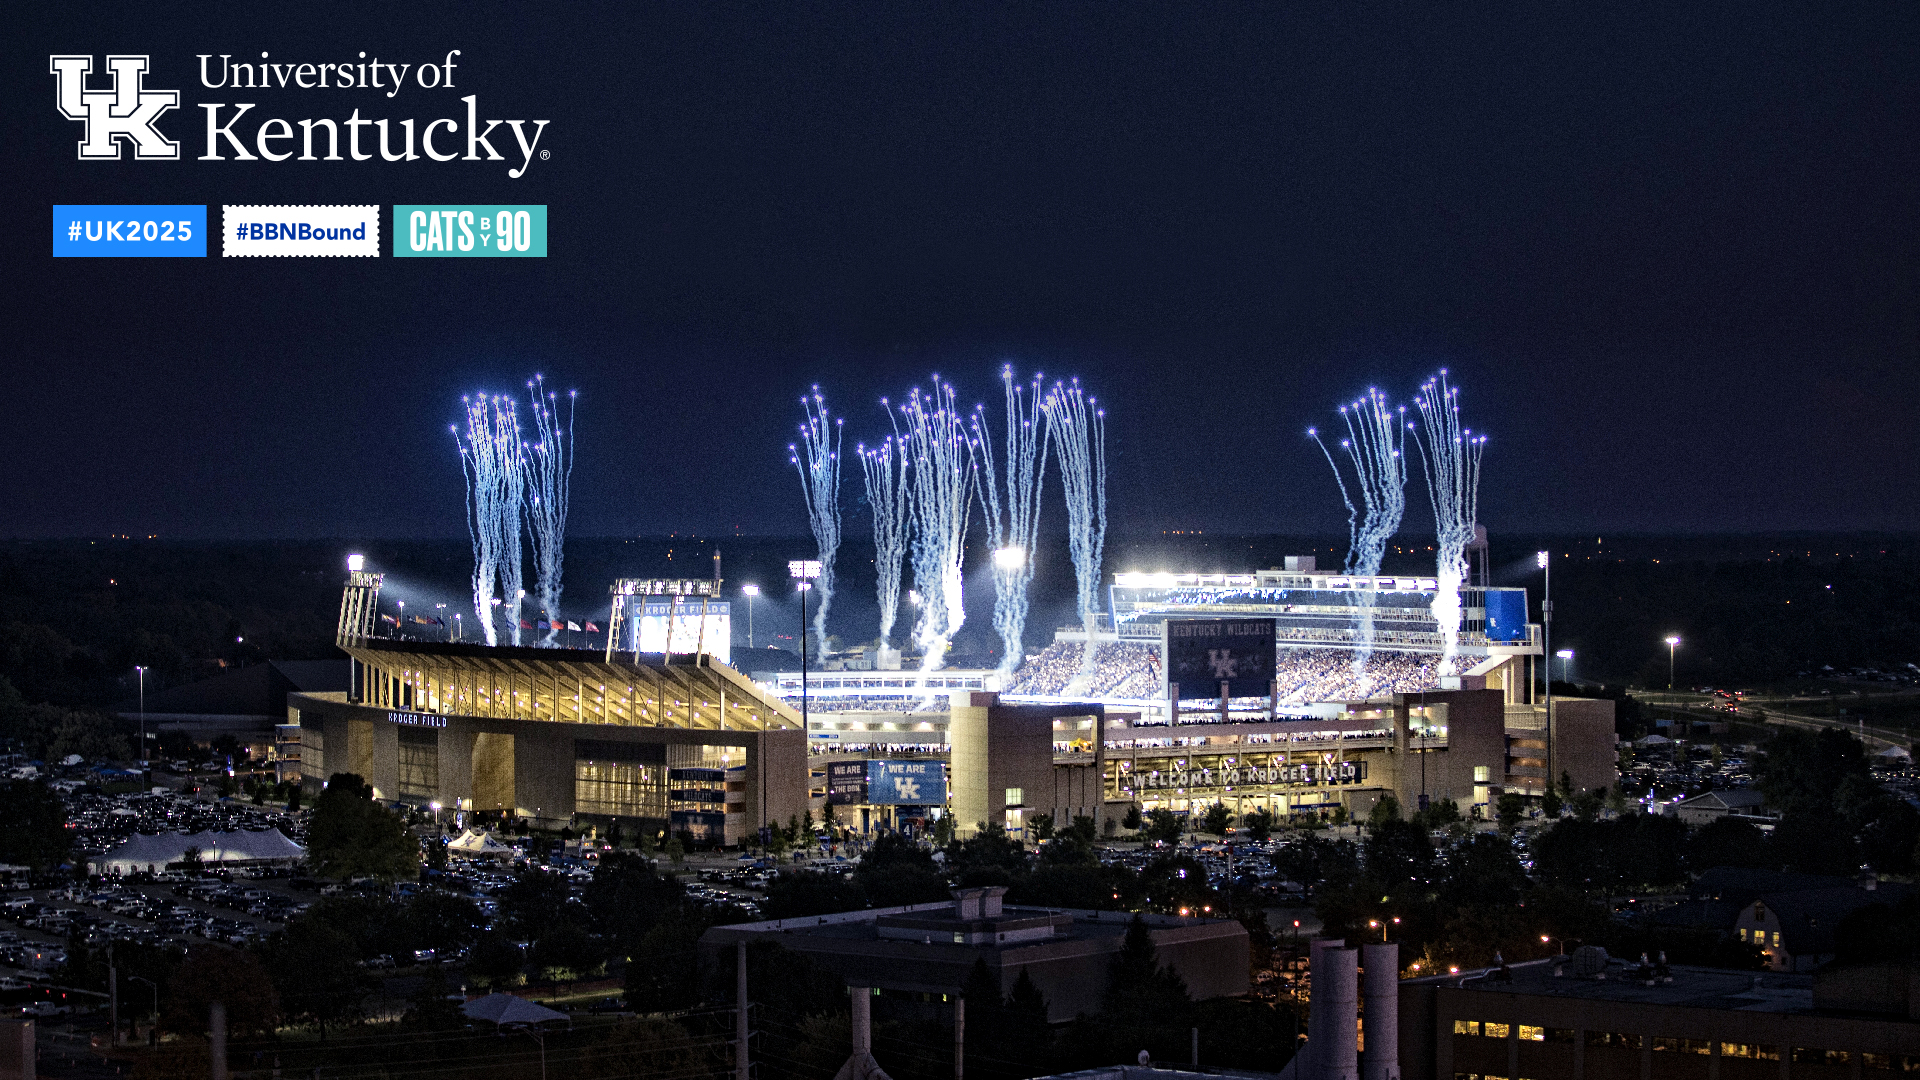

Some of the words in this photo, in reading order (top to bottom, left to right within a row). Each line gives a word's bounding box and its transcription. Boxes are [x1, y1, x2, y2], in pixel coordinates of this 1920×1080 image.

[689, 605, 719, 614] FILD
[1173, 624, 1222, 636] KENTUCKY
[1227, 623, 1271, 636] WILDCATS
[388, 712, 418, 725] KROGER
[422, 715, 447, 728] FIELD
[834, 766, 846, 775] WE
[847, 765, 861, 774] ARE
[888, 764, 905, 774] WE
[906, 764, 926, 774] ARE
[1133, 772, 1213, 787] WELCOME
[1221, 771, 1240, 783] TO
[1247, 768, 1308, 782] KROGER
